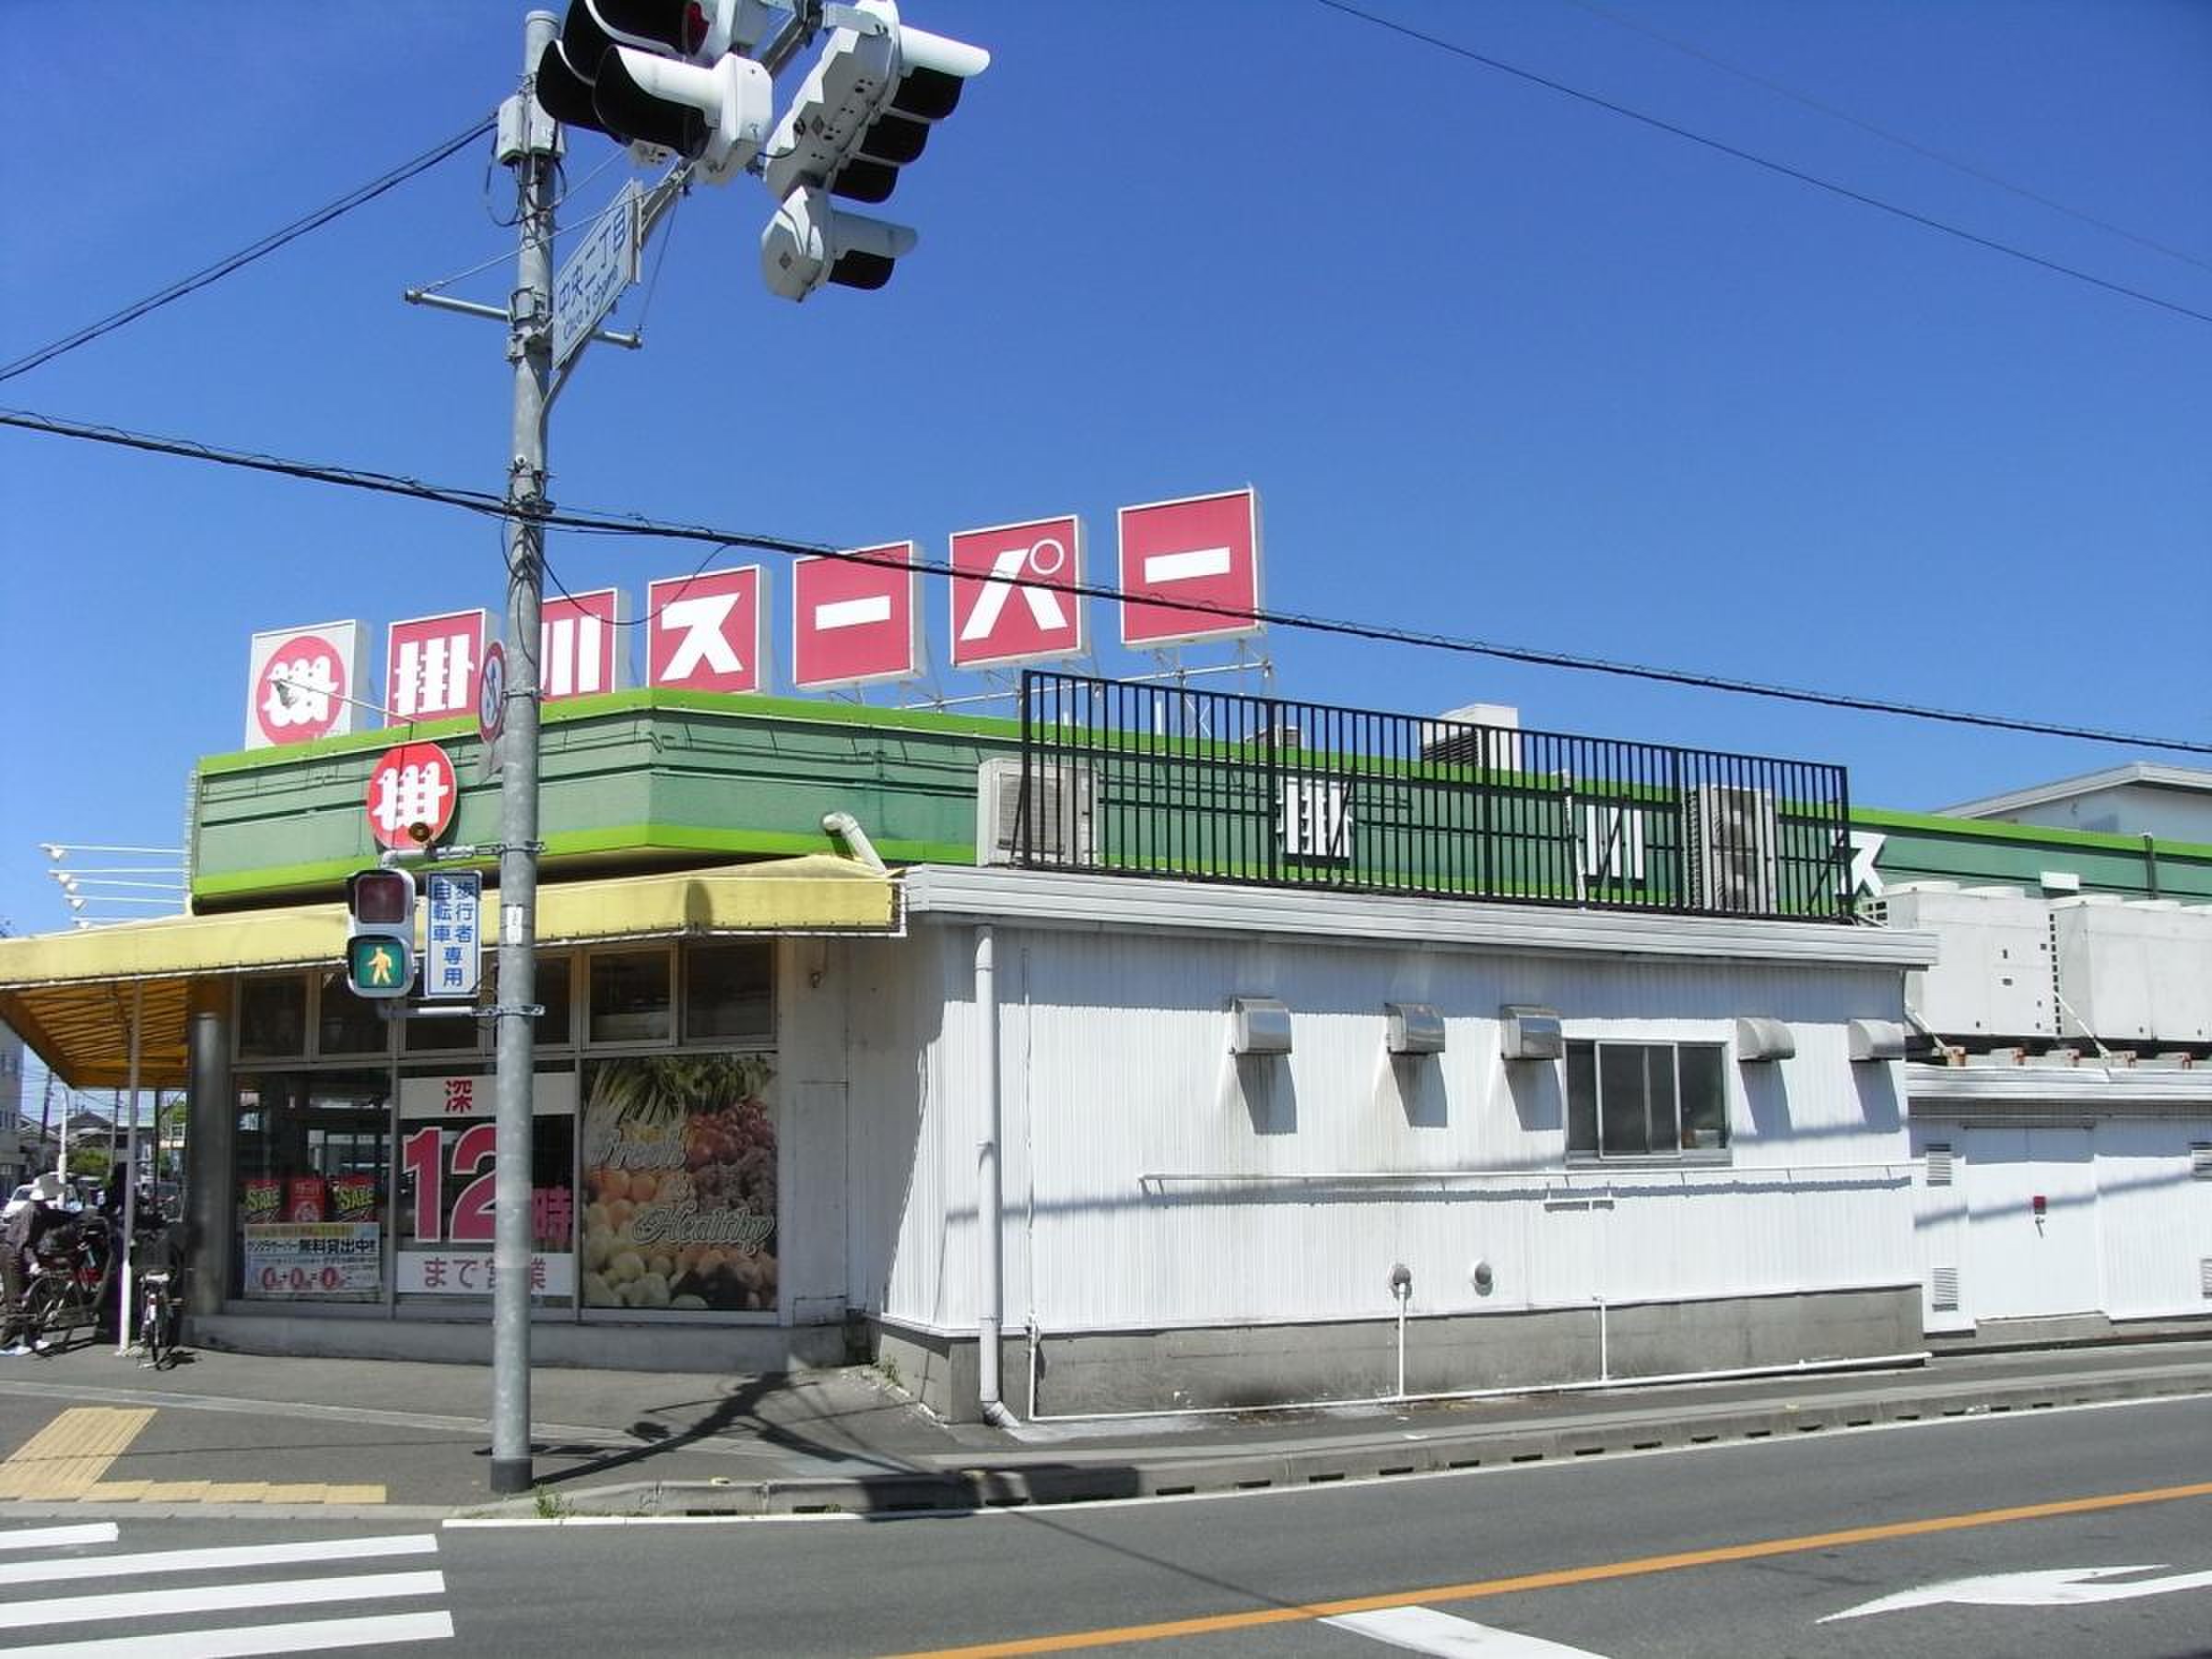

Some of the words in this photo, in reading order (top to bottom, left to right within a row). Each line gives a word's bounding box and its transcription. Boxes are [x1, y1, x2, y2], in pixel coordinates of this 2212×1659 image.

[442, 947, 463, 988] 専用
[338, 1185, 375, 1210] SALE
[631, 1203, 775, 1254] Healthy
